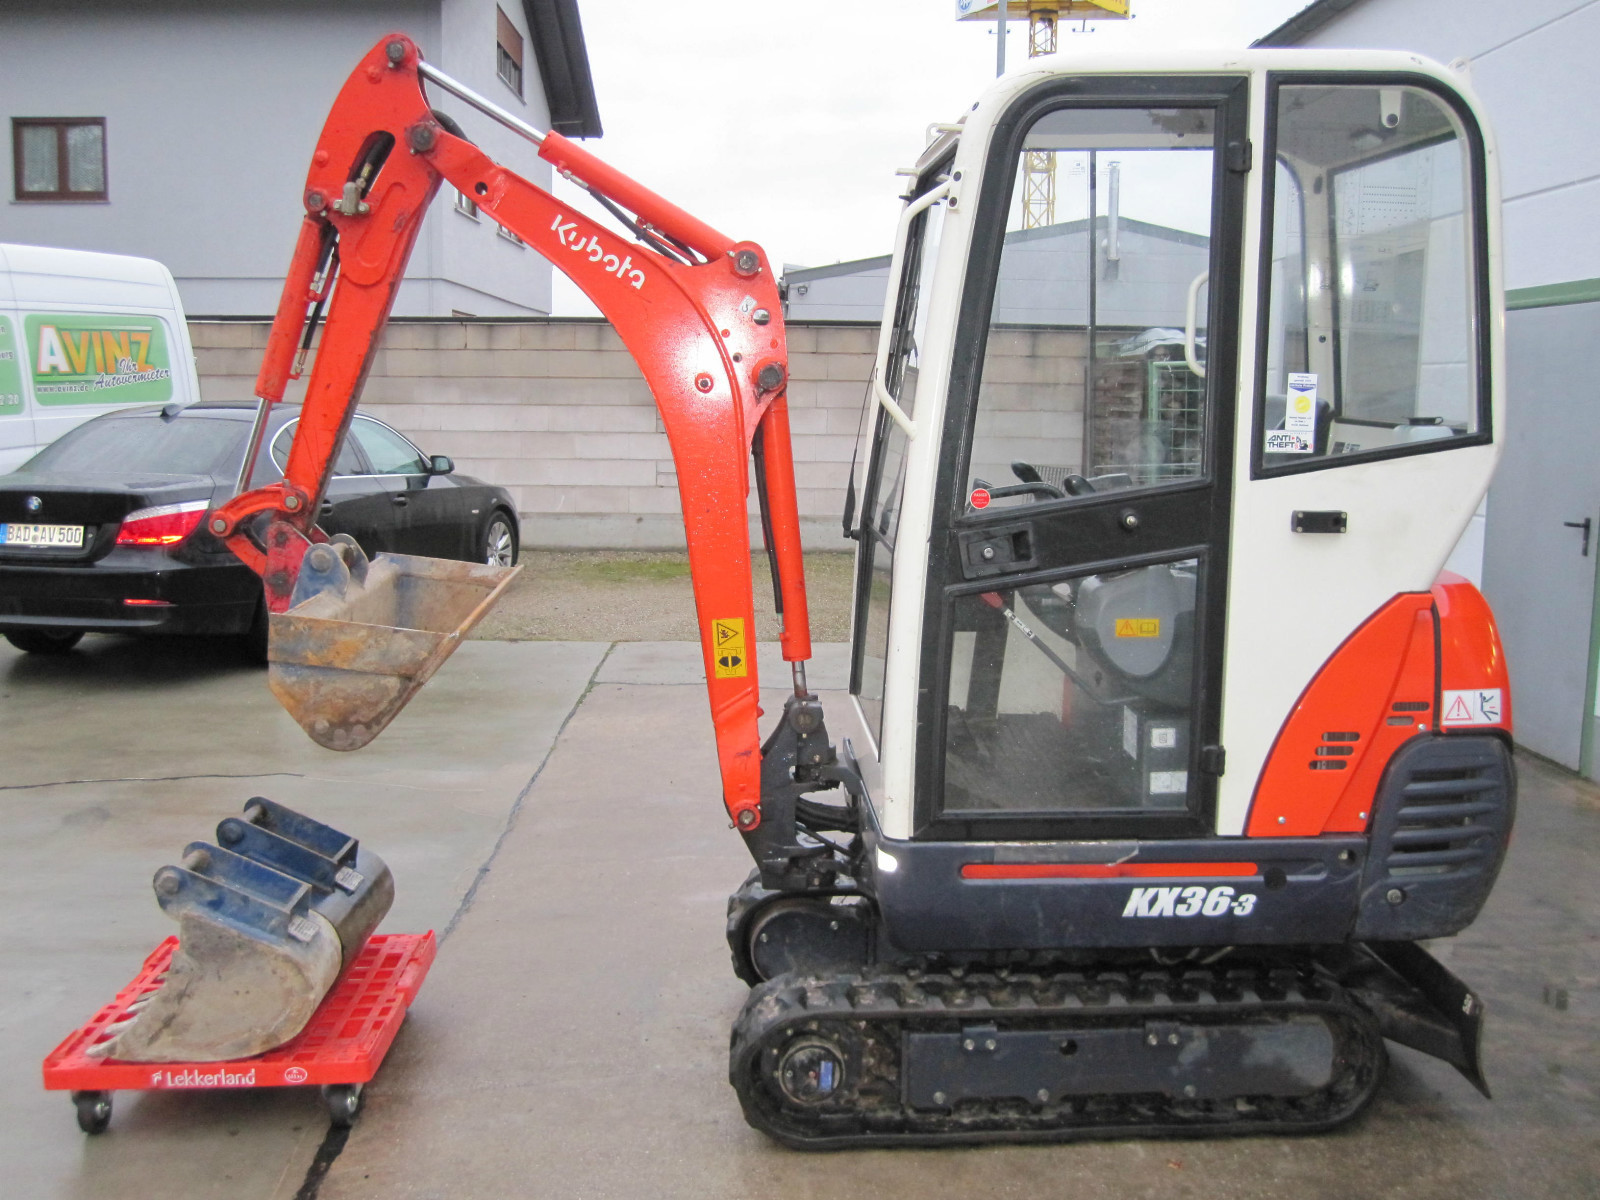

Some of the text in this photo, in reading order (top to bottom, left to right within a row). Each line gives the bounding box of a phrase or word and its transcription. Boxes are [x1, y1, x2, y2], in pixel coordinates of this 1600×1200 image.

[550, 214, 645, 289] Kubota
[37, 325, 154, 374] AVINZ
[119, 358, 138, 374] Ihr
[37, 383, 89, 393] www.avinz.de
[93, 368, 170, 391] Autovermieter
[8, 526, 82, 543] BAD AV 500
[1122, 886, 1257, 917] KX36-3
[167, 1068, 256, 1087] Lekkerland
